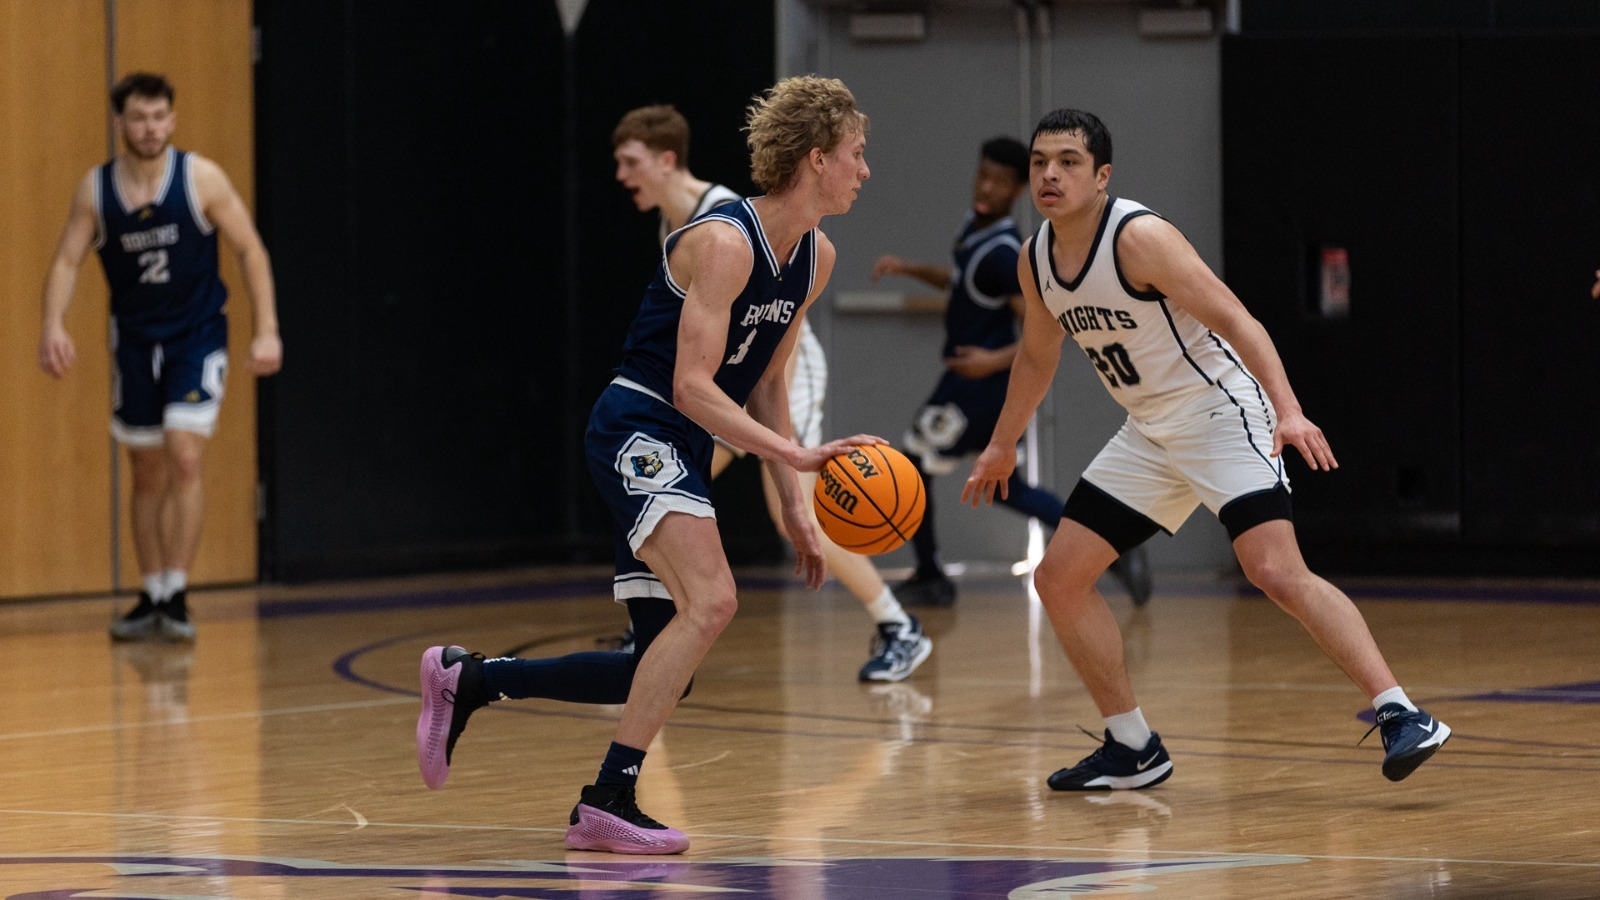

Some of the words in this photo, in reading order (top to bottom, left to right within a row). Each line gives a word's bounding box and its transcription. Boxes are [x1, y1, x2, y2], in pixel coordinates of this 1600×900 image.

[1057, 305, 1138, 336] NIGHTS
[847, 448, 879, 479] NCA
[819, 468, 858, 515] Wilso
